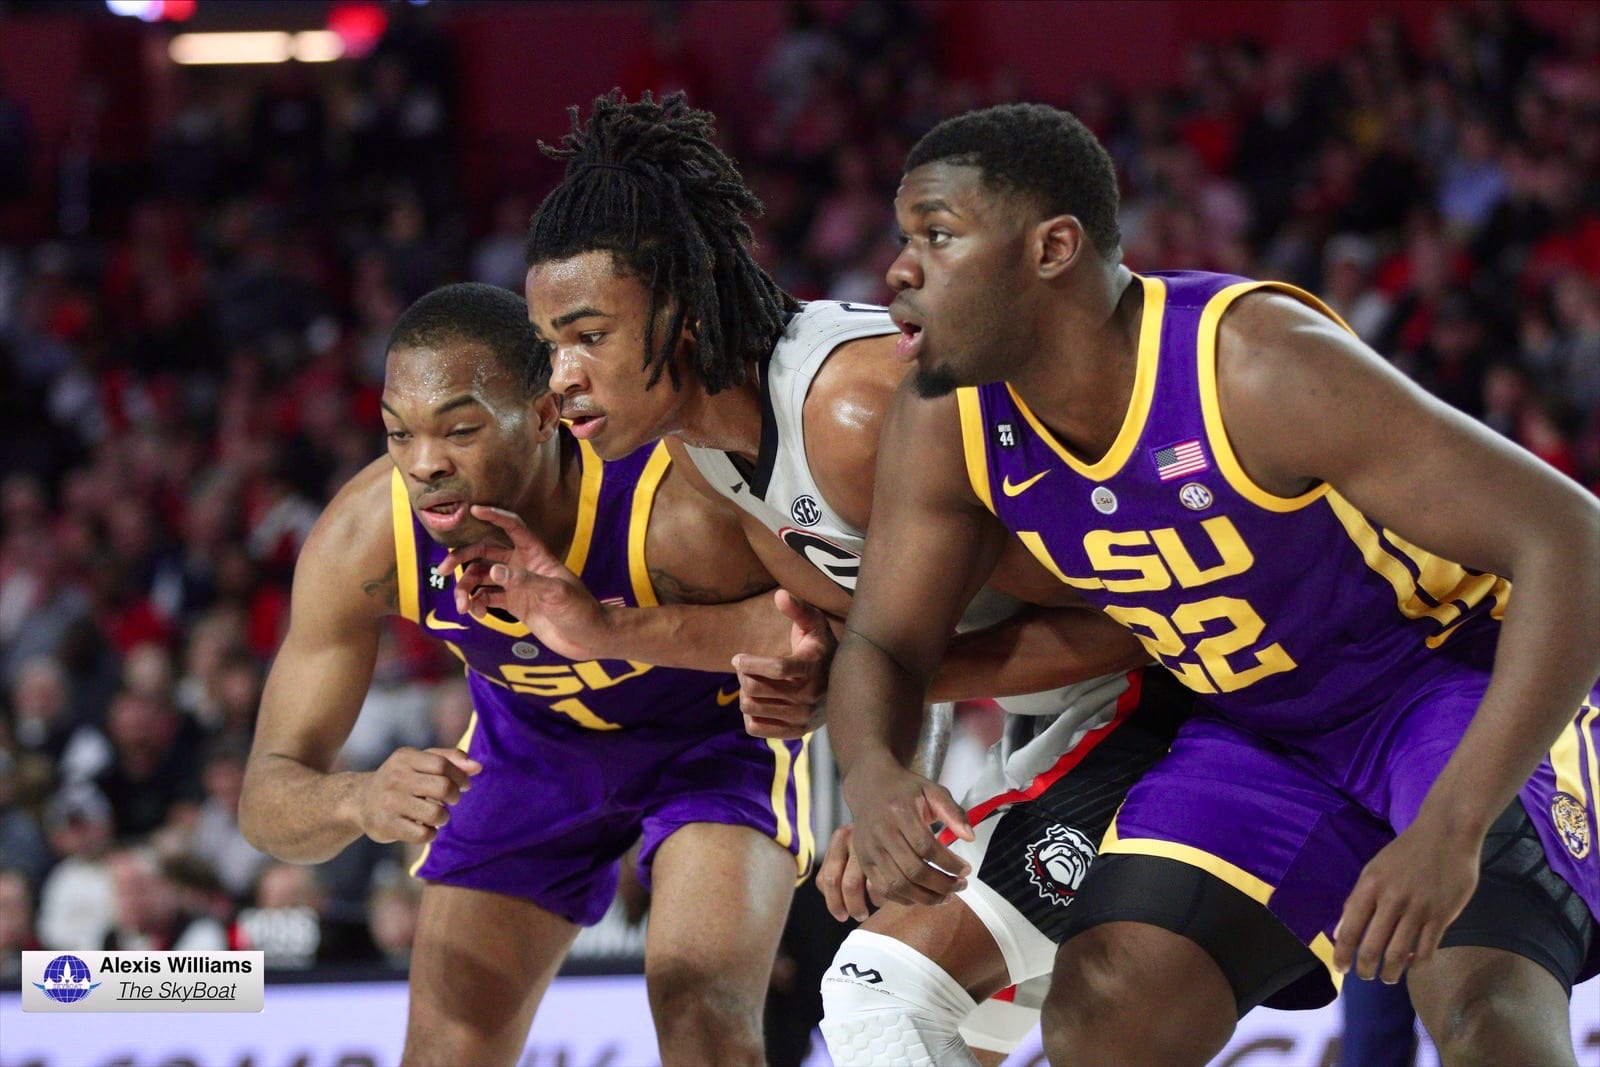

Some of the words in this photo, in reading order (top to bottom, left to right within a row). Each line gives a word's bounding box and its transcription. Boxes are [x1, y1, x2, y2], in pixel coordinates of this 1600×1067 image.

[1000, 431, 1015, 446] 44
[793, 497, 819, 524] SEC
[1016, 516, 1254, 593] LSU
[1103, 596, 1298, 694] 22
[549, 697, 623, 731] 1
